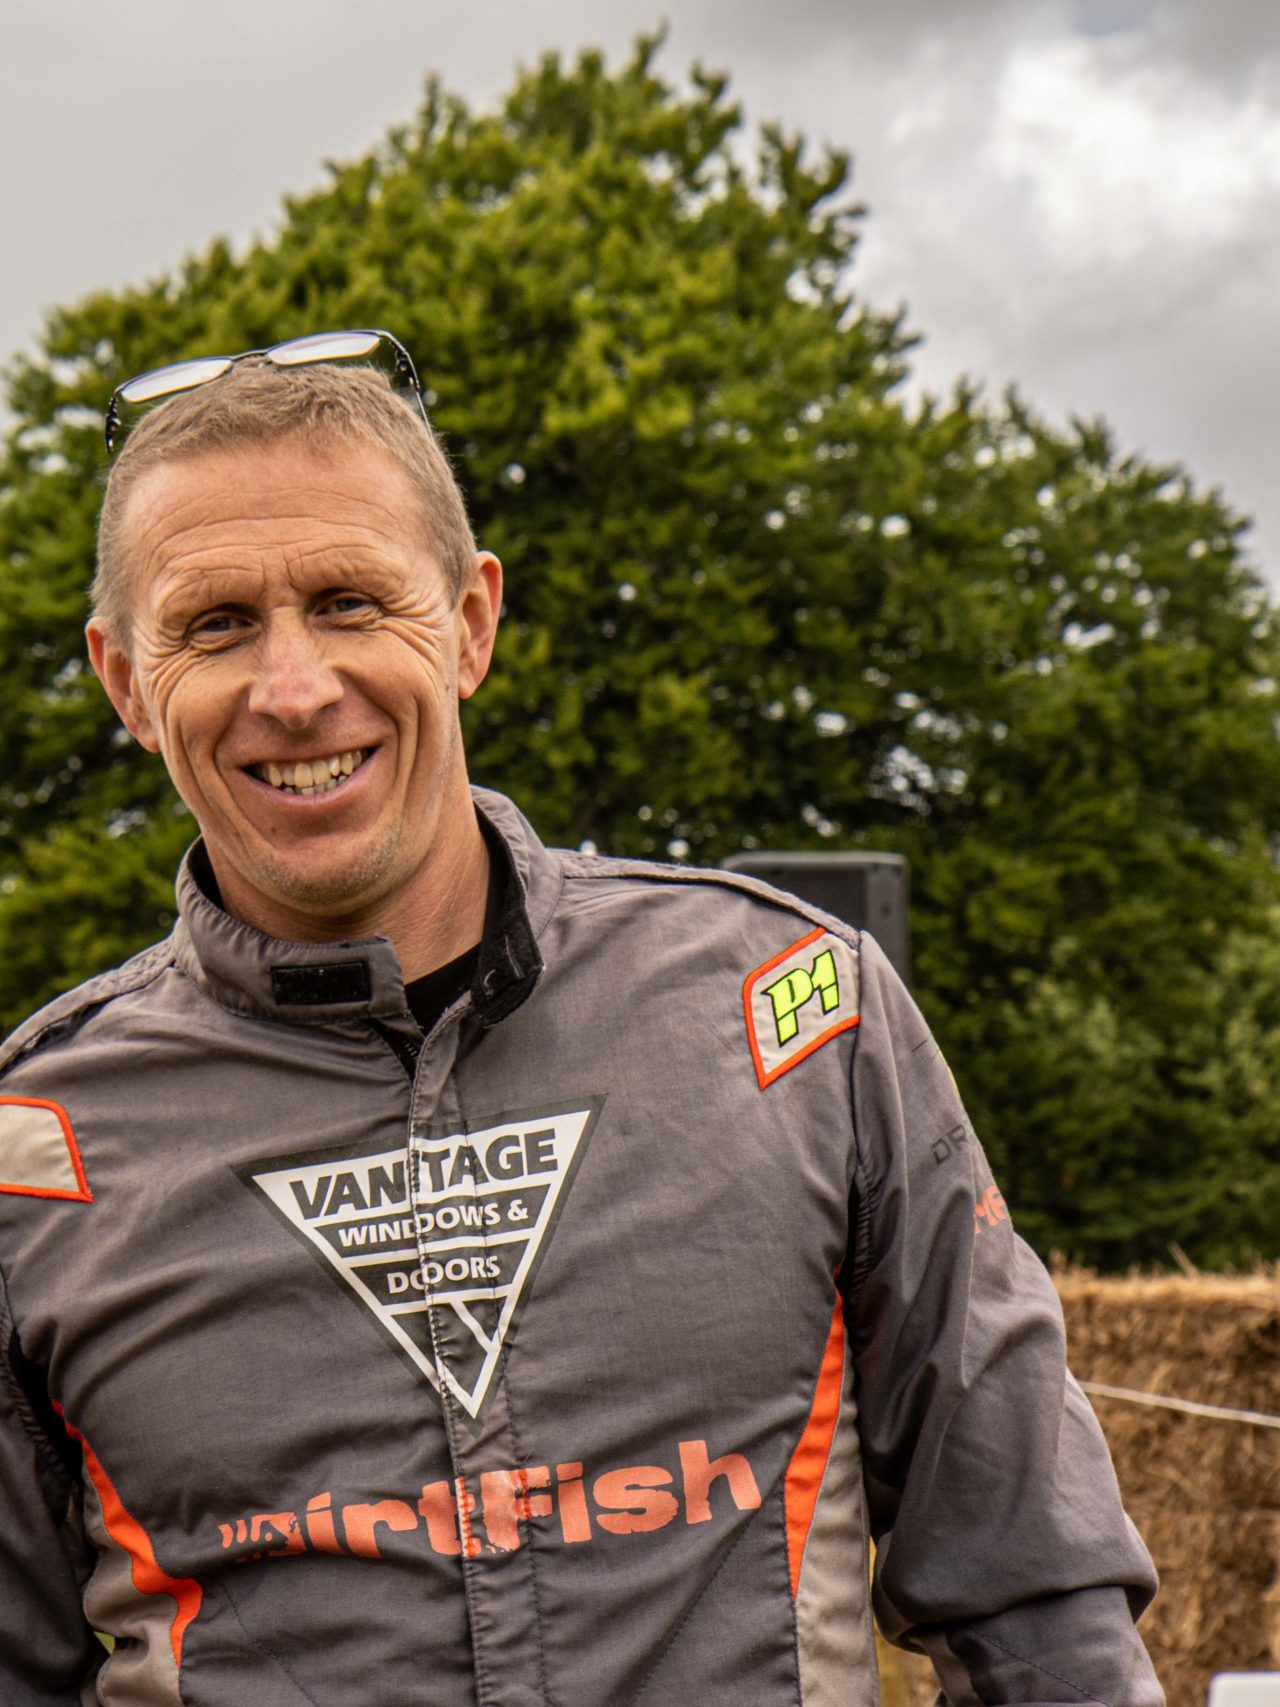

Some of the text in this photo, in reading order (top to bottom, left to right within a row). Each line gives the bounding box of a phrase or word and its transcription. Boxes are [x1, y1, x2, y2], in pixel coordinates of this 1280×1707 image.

[760, 949, 840, 1047] P1
[289, 1128, 558, 1220] VANTAGE
[338, 1199, 528, 1248] WINDOWS &
